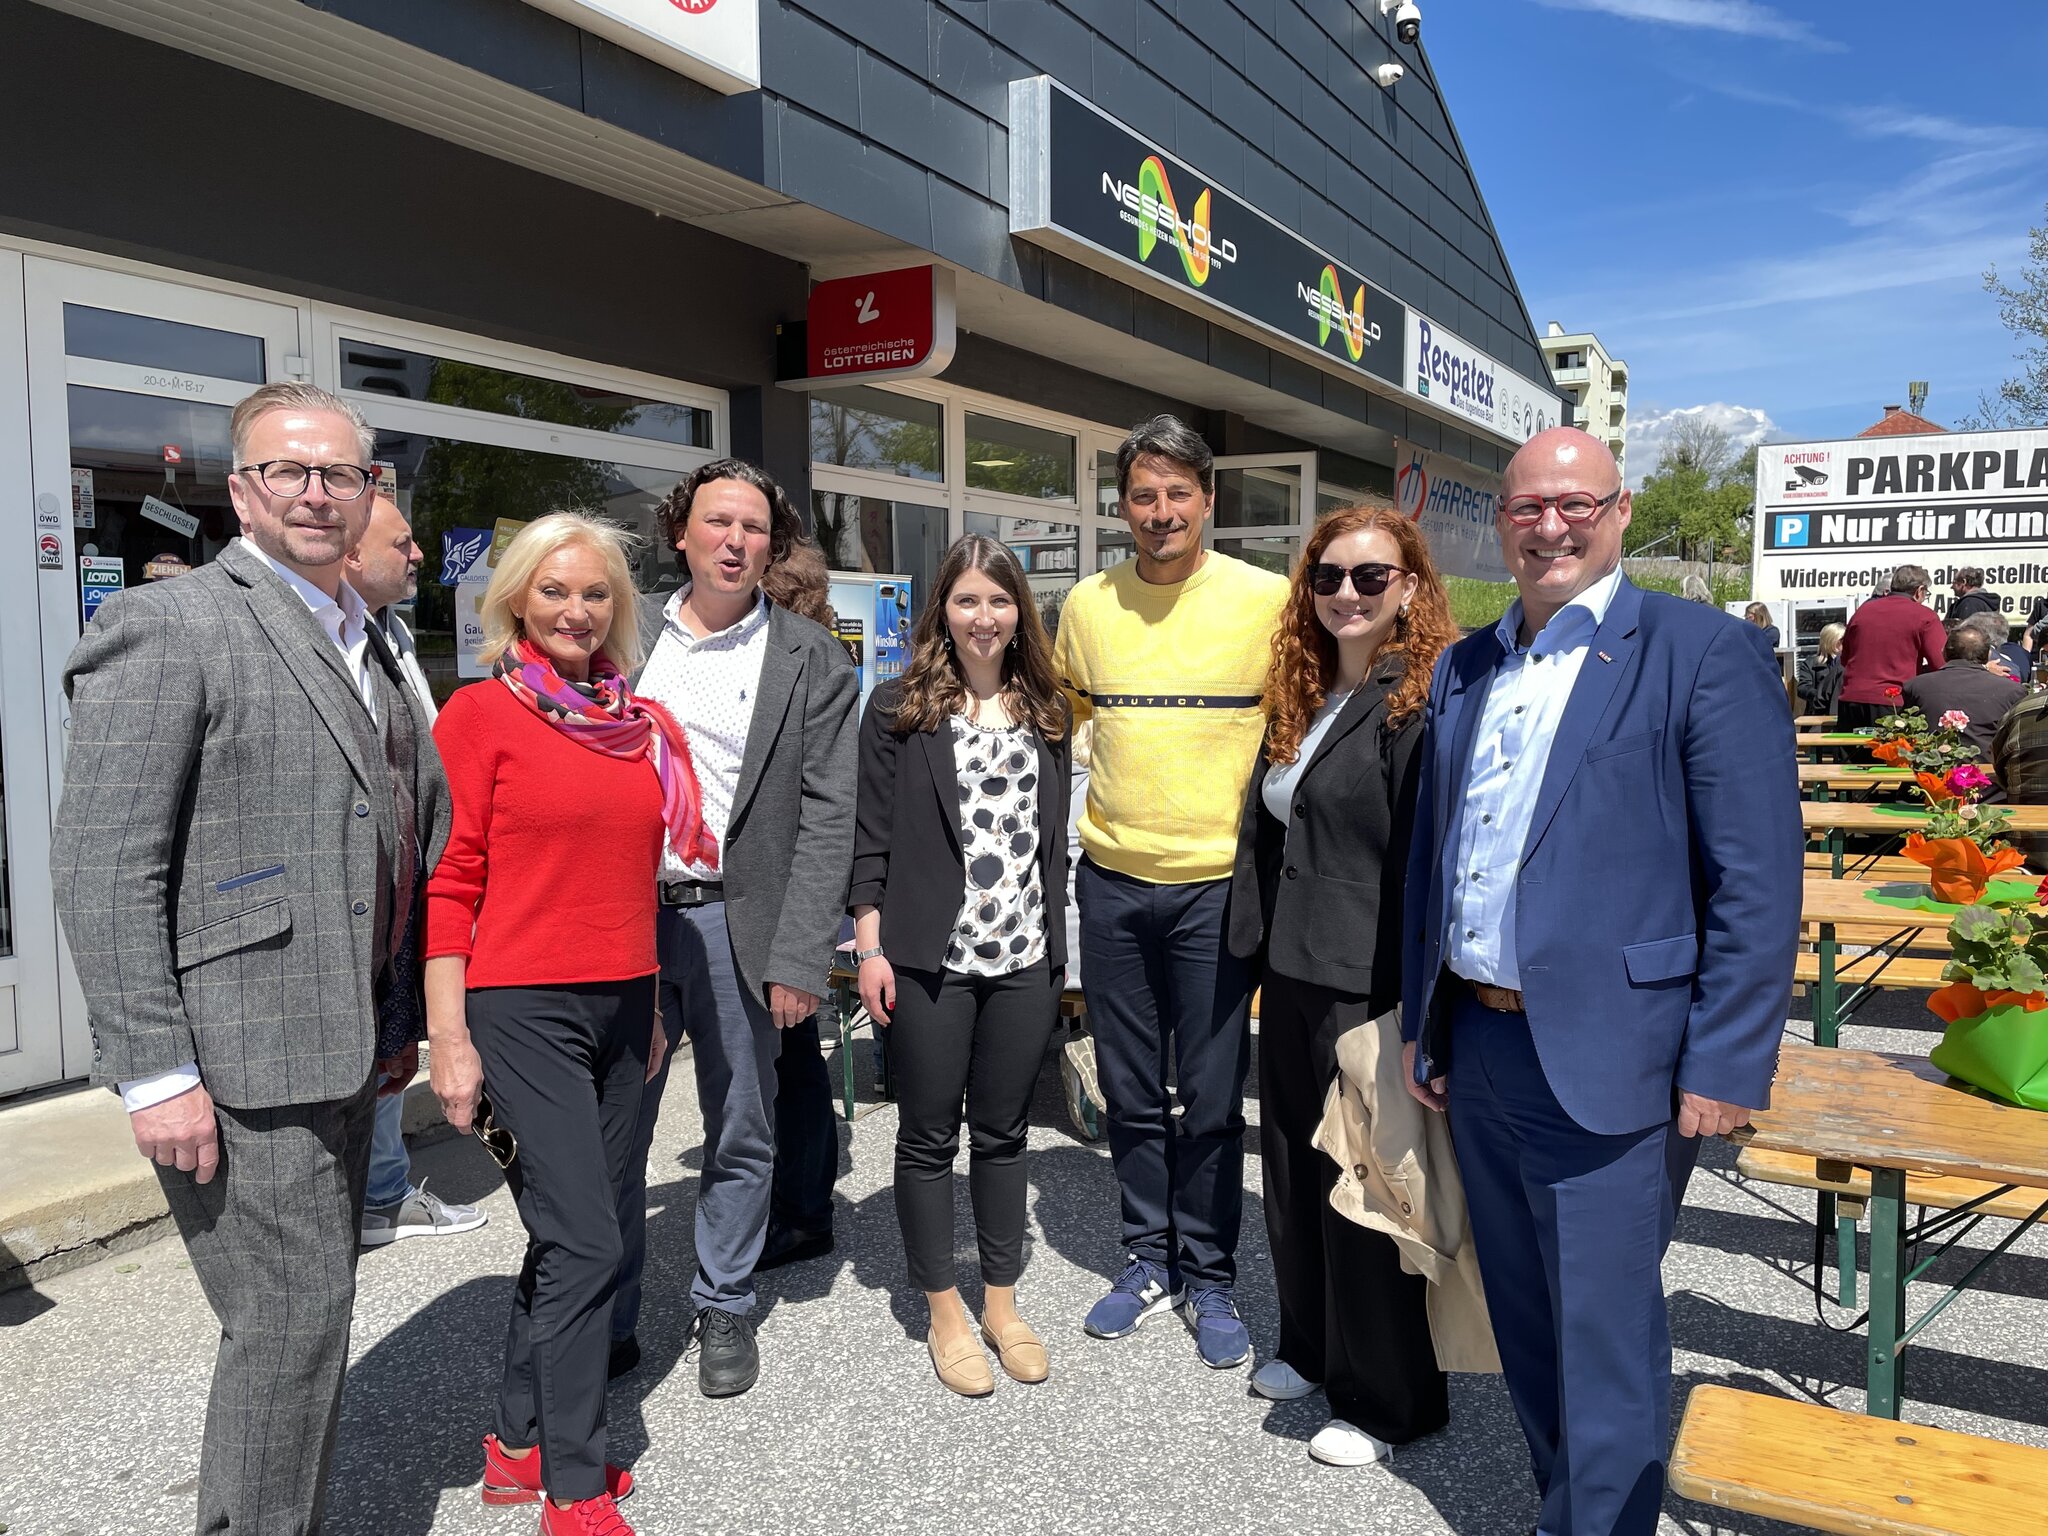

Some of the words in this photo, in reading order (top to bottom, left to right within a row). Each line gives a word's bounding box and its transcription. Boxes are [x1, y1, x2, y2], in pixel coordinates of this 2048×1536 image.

[1102, 171, 1237, 263] NESSHOLD
[1297, 281, 1381, 341] NESSHOLD
[823, 338, 915, 356] österreichische
[823, 348, 915, 369] LOTTERIEN
[1418, 318, 1494, 409] Respatex
[1784, 452, 1825, 465] ACHTUNG
[39, 514, 59, 523] ÖWD
[144, 502, 196, 531] GESCHLOSSEN
[1821, 514, 1890, 543] Nur
[1897, 509, 1956, 541] für
[1964, 508, 2048, 539] Kun
[41, 555, 60, 564] ÖWD
[151, 564, 189, 575] ZIEHEN
[87, 572, 119, 583] LOTTO
[875, 635, 898, 648] Winston
[1107, 697, 1205, 706] NAUTICA
